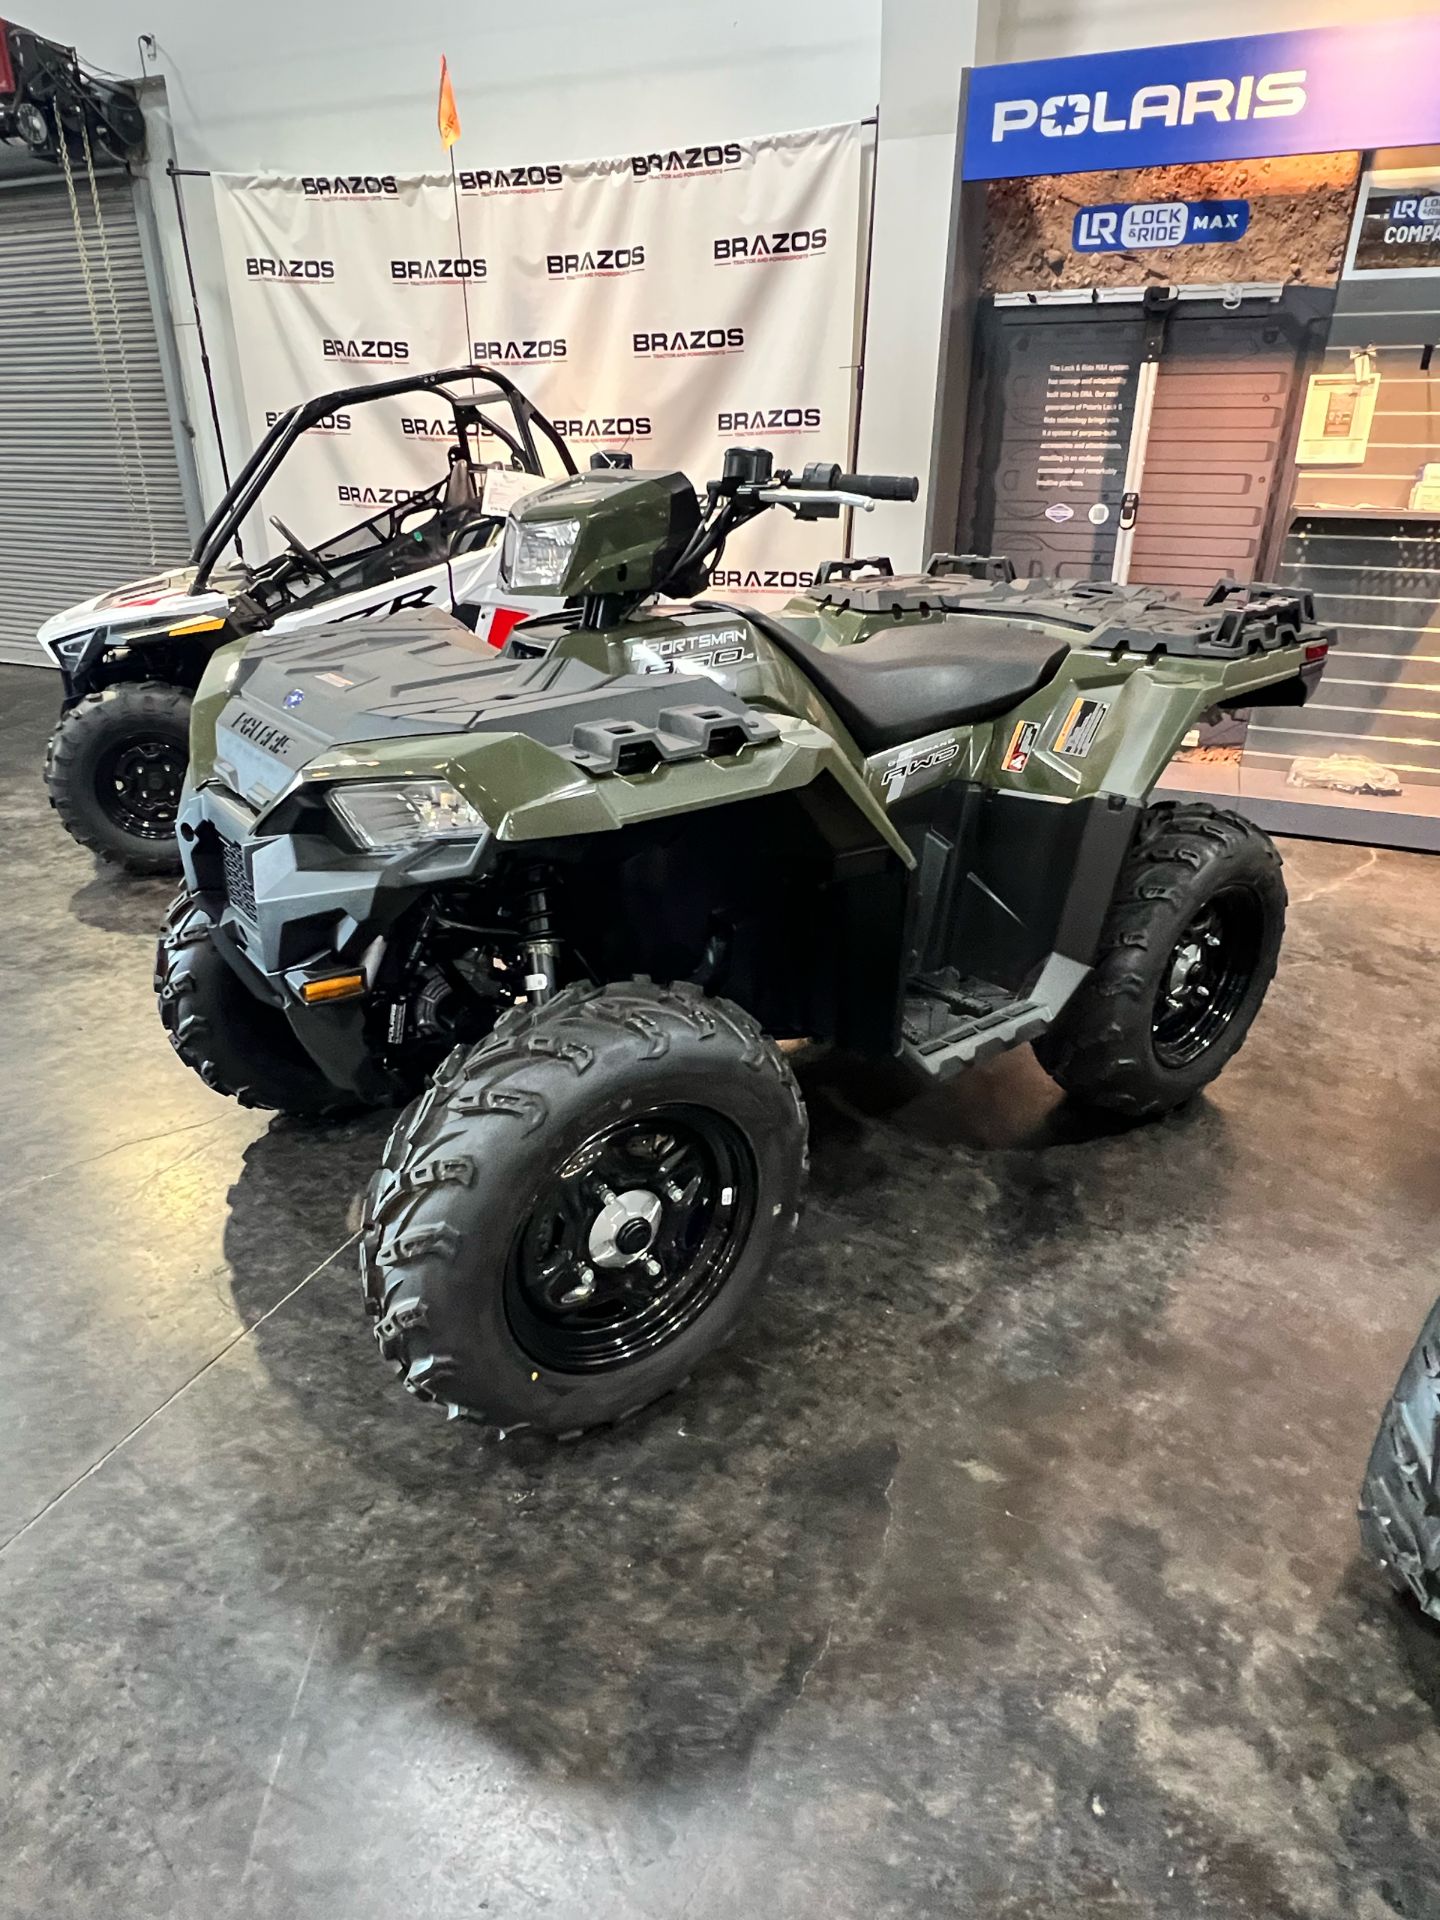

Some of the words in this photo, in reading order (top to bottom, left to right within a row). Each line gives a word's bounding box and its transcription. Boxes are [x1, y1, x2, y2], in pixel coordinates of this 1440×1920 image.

[991, 70, 1307, 142] POLARIS
[631, 143, 742, 176] BRAZOS
[301, 175, 397, 195] BRAZOS
[459, 165, 563, 190] BRAZOS
[1130, 208, 1182, 226] LOCK
[1393, 199, 1418, 219] LR
[1078, 212, 1118, 246] LR
[1193, 213, 1239, 231] MAX
[714, 228, 827, 260] BRAZOS
[246, 258, 335, 278] BRAZOS
[391, 259, 488, 279] BRAZOS
[547, 245, 645, 274] BRAZOS
[323, 340, 409, 359] BRAZOS
[474, 339, 567, 360] BRAZOS
[633, 328, 744, 352] BRAZOS
[266, 412, 351, 430] BOS
[553, 417, 651, 437] BRAZOS
[718, 408, 820, 431] BRAZOS
[713, 571, 814, 588] BRAZOS
[881, 744, 960, 786] AWD
